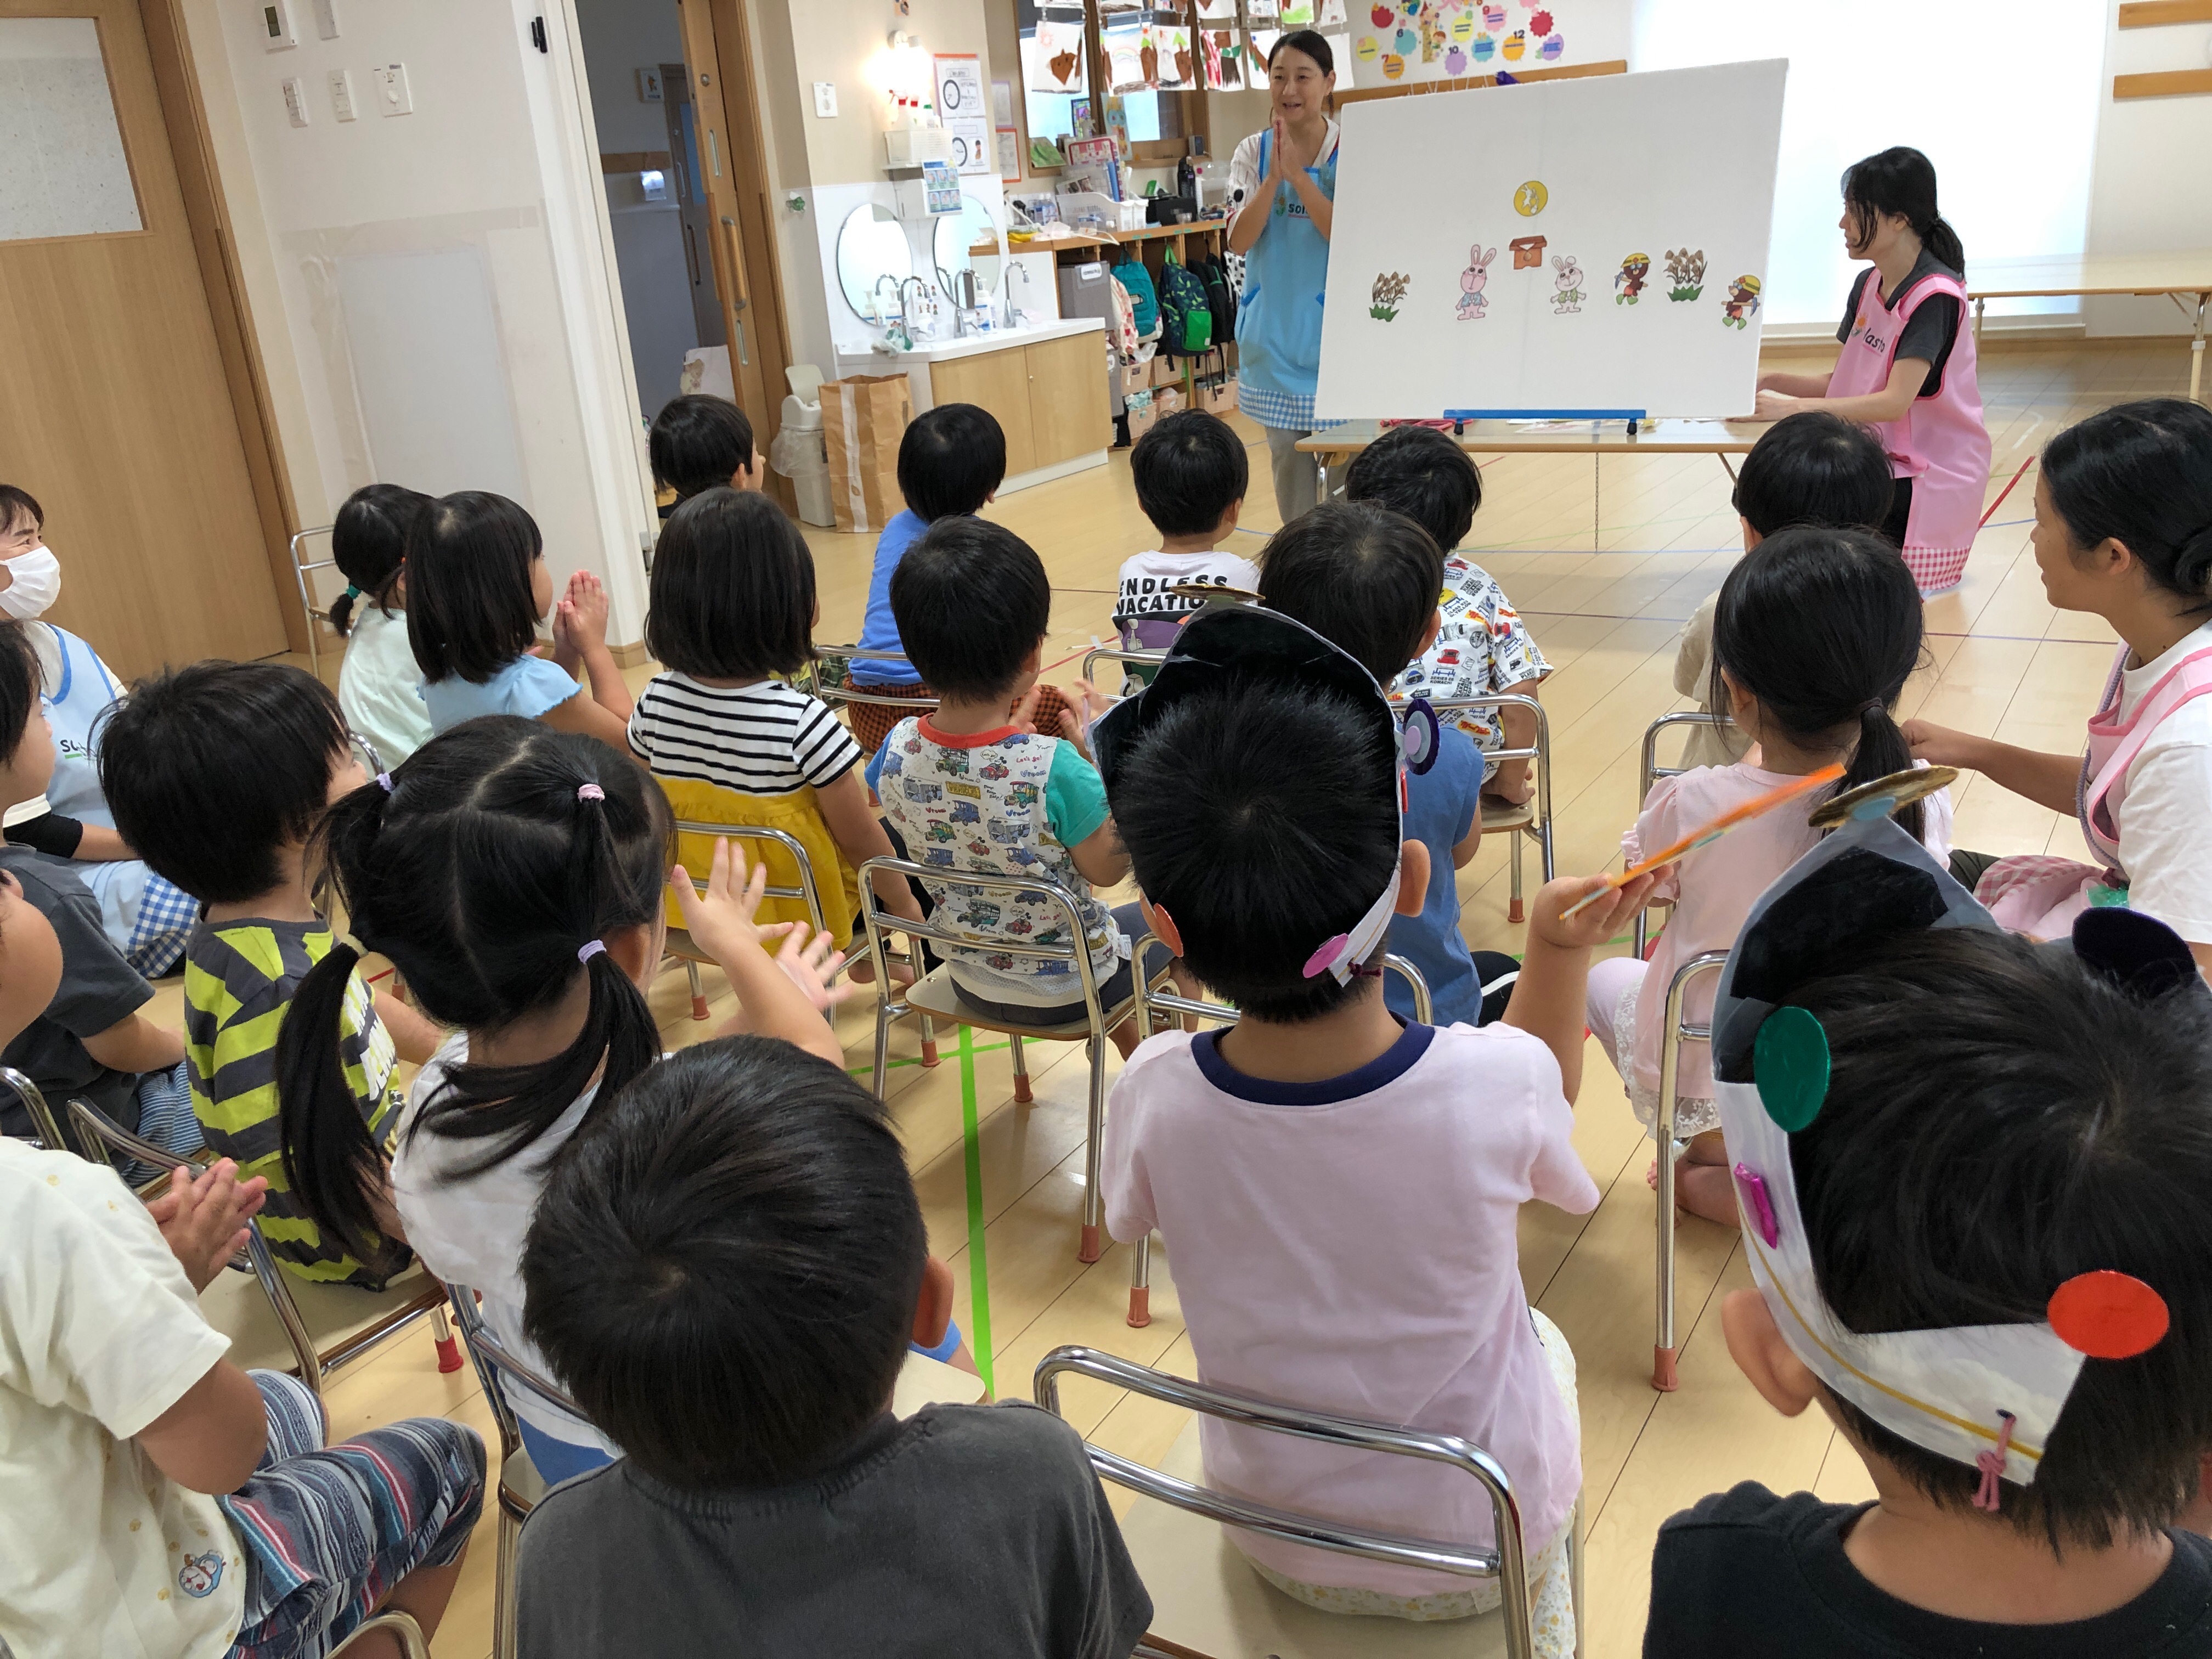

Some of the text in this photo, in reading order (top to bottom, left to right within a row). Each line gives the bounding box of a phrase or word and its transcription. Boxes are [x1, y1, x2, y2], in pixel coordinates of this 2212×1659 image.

[1397, 29, 1403, 38] 6
[1514, 30, 1525, 40] 12
[1448, 46, 1459, 54] 10
[1116, 594, 1205, 616] VACATIO
[1447, 606, 1461, 615] CLASS
[1006, 809, 1030, 817] Vroom
